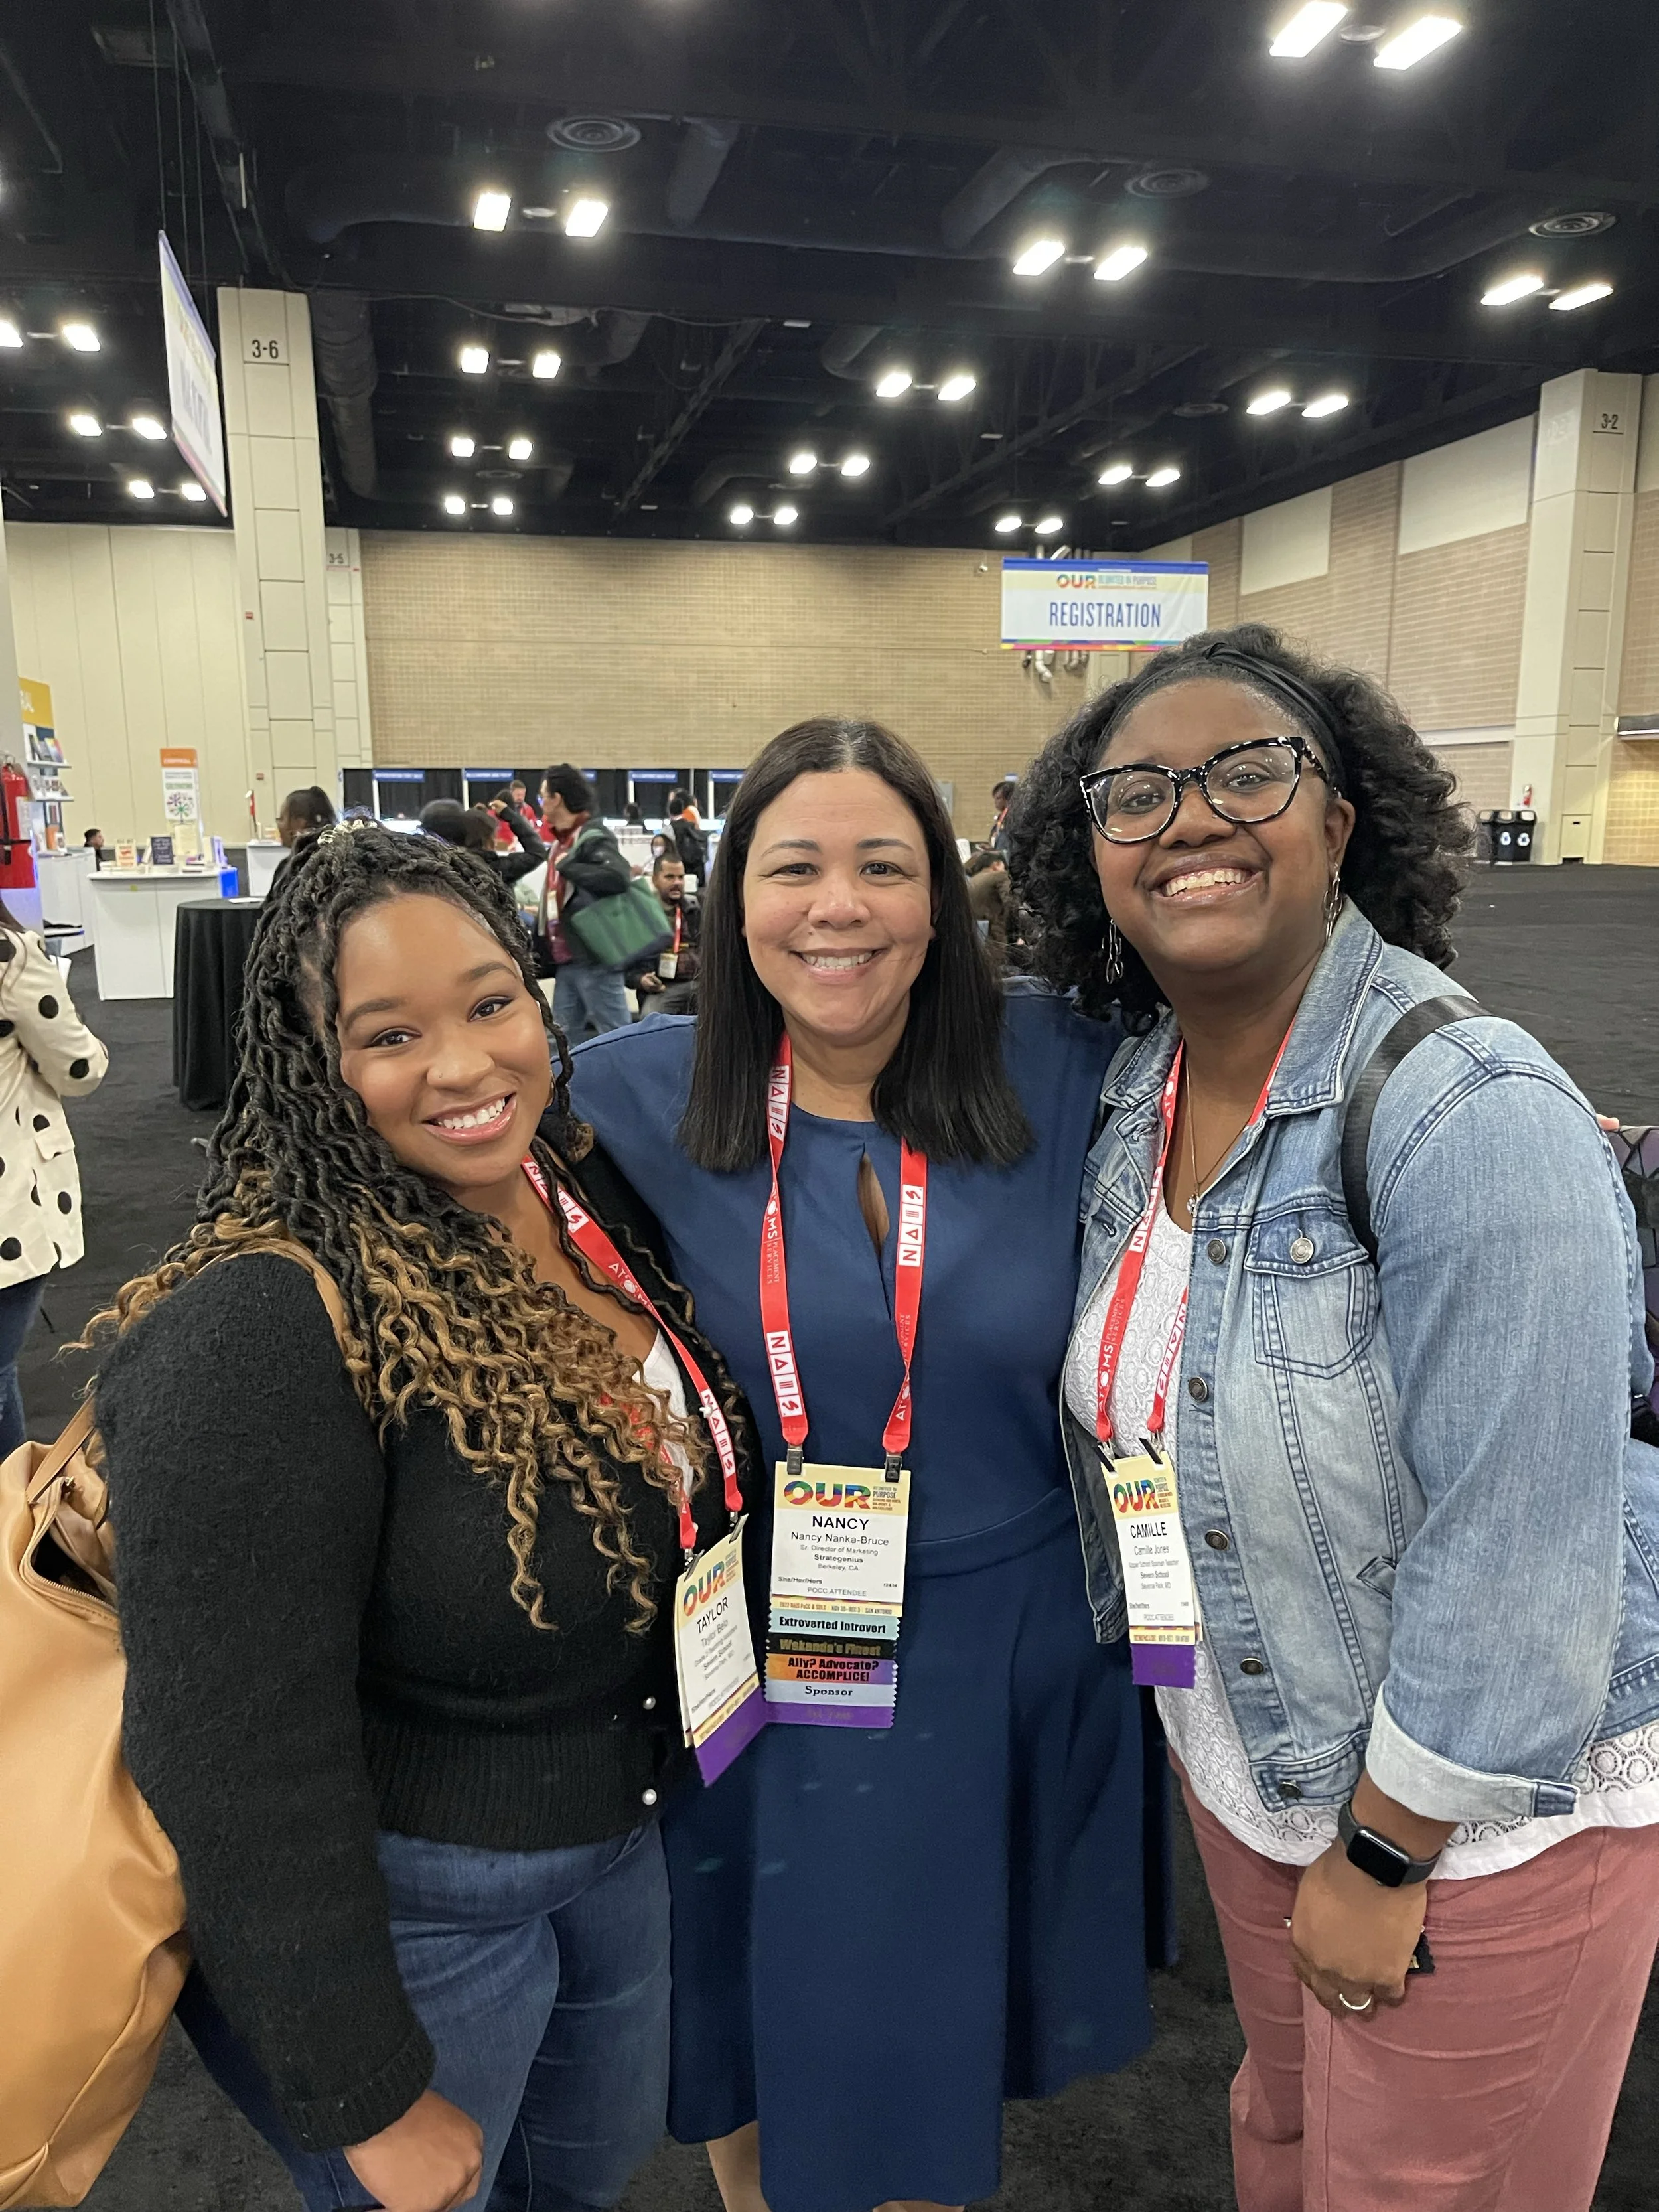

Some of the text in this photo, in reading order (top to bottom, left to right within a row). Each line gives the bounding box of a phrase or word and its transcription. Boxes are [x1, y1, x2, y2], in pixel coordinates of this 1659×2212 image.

[252, 339, 279, 359] 3-6
[1601, 413, 1619, 430] 3-2
[1056, 573, 1096, 589] OUR
[1049, 601, 1161, 627] REGISTRATION
[783, 1480, 871, 1510] OUR
[1113, 1479, 1160, 1514] OUR
[812, 1516, 870, 1531] NANCY
[1130, 1521, 1167, 1539] CAMILLE
[791, 1531, 889, 1546] Nancy Nanka-Bruce
[811, 1544, 837, 1553] Director
[846, 1547, 879, 1556] Marketing
[814, 1553, 864, 1564] Strategenius
[683, 1560, 726, 1617] OUR
[829, 1588, 867, 1597] ATTENDEE
[697, 1596, 729, 1633] TAYLOR
[779, 1616, 887, 1634] Extroverted Introvert
[779, 1638, 843, 1654] Wakanda's
[788, 1657, 879, 1670] Ally? Advocate?
[796, 1668, 871, 1682] ACCOMPLICE!
[804, 1685, 853, 1696] Sponsor
